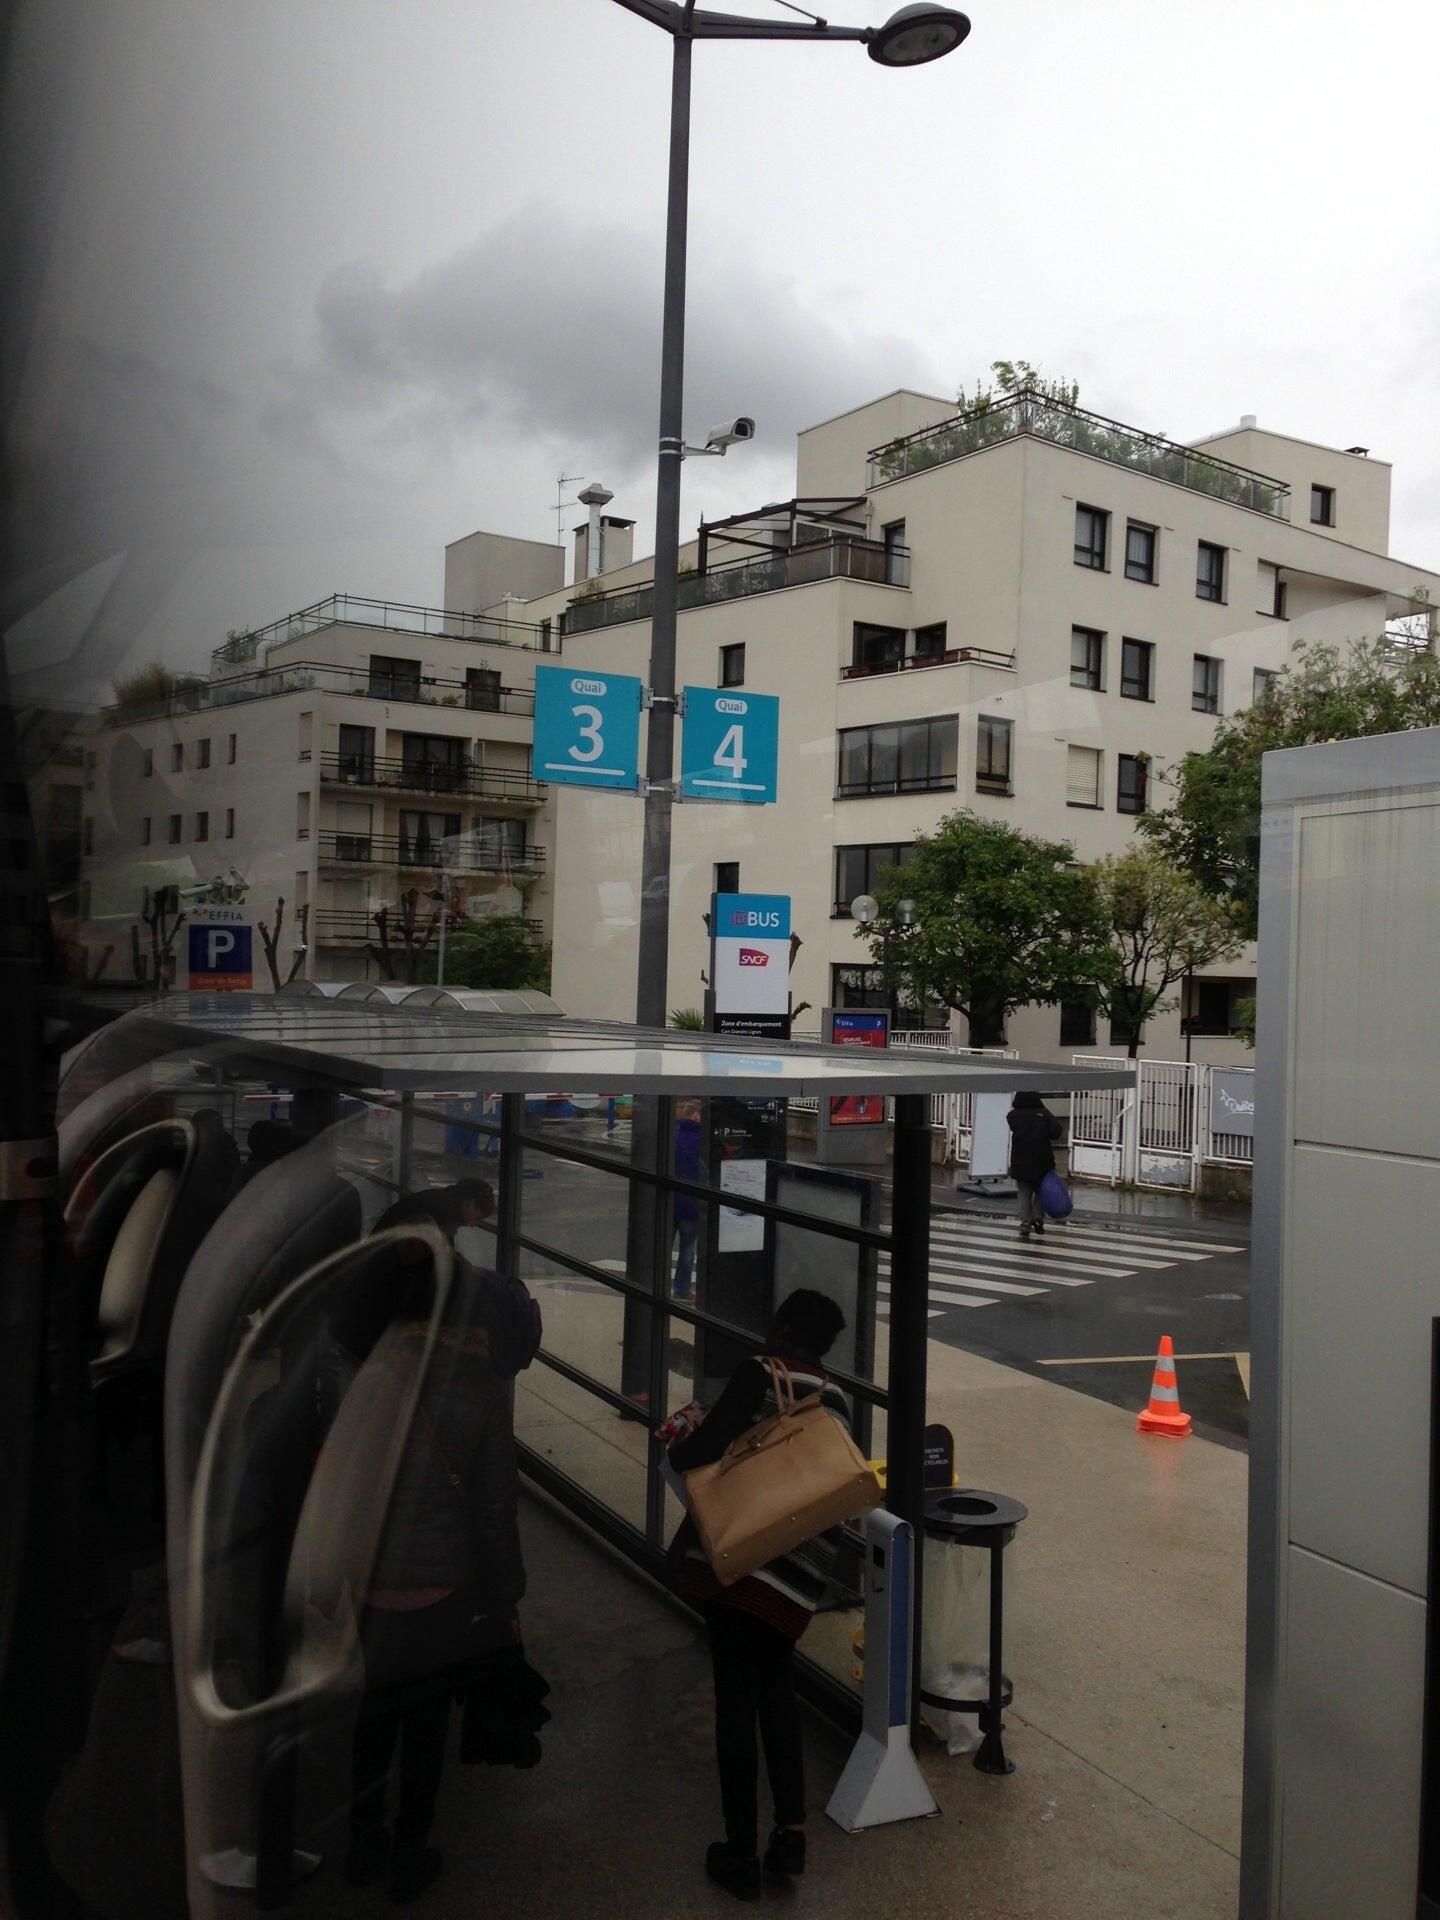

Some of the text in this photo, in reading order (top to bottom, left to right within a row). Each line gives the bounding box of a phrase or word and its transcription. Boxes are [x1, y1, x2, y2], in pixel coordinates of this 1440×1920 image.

[575, 681, 601, 692] Quai
[718, 700, 743, 712] Quai
[568, 705, 604, 762] 3
[713, 725, 747, 778] 4
[209, 911, 243, 920] EFFIA
[208, 930, 235, 968] P
[740, 955, 768, 964] SNCF
